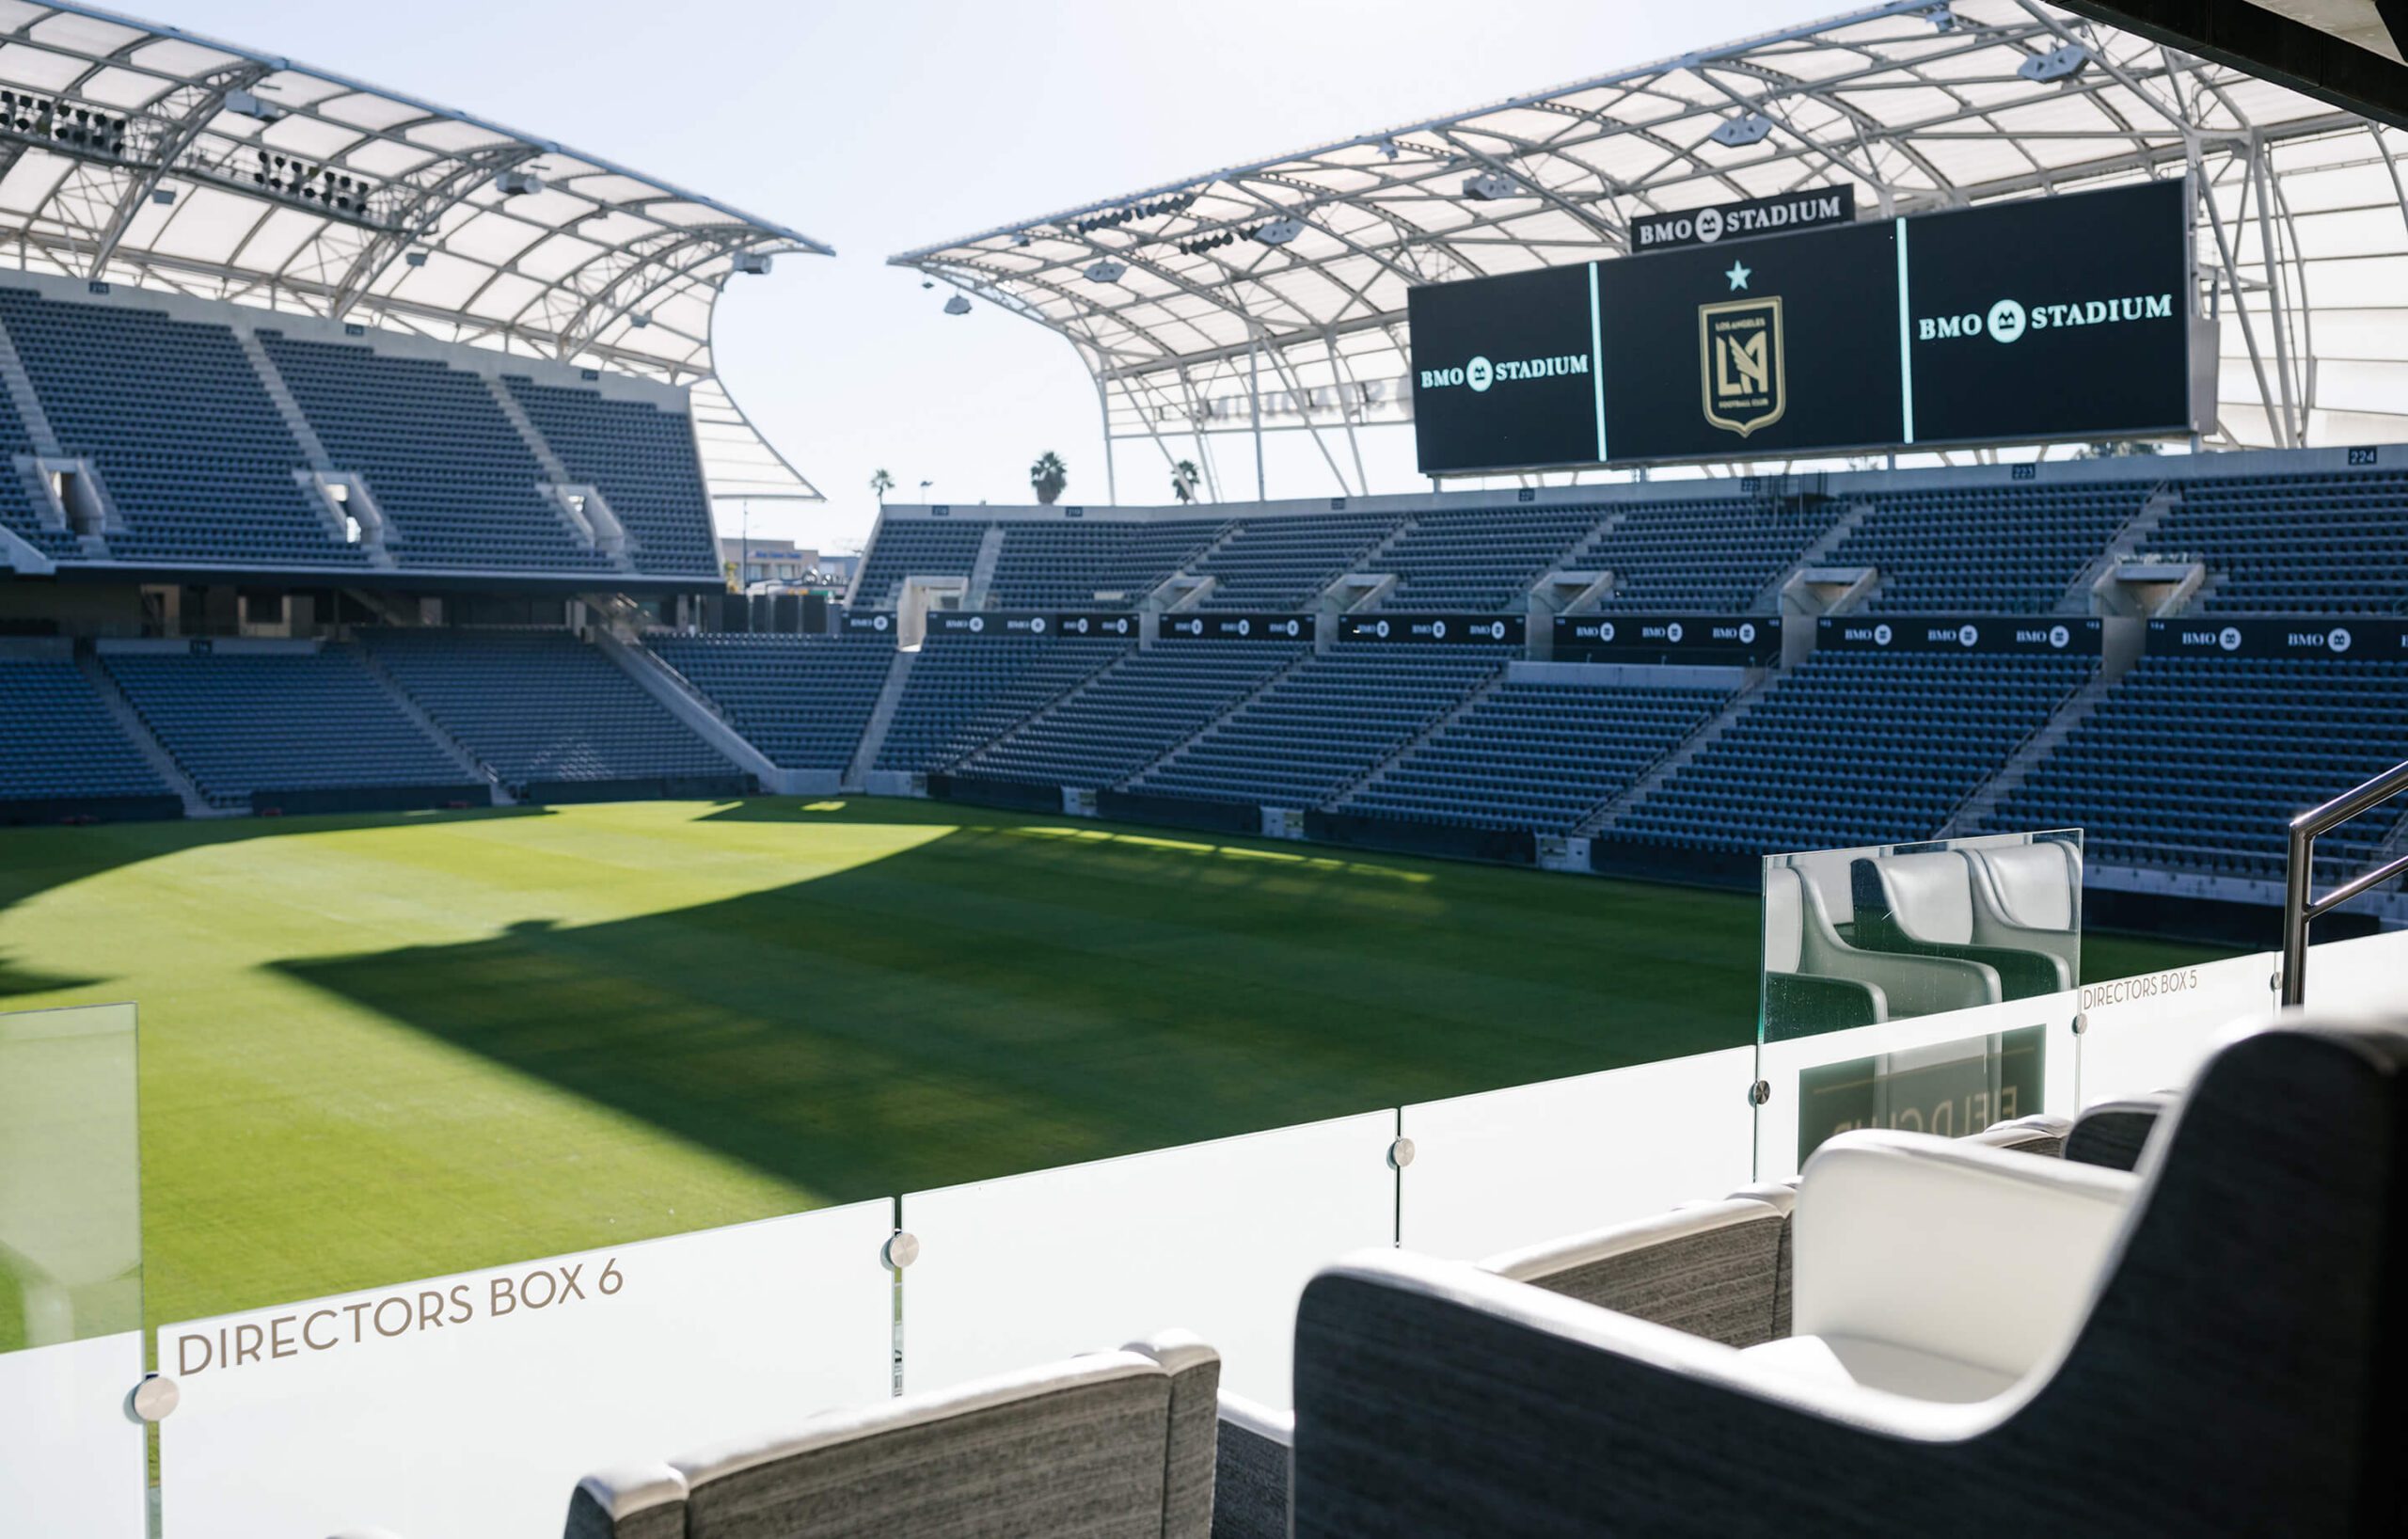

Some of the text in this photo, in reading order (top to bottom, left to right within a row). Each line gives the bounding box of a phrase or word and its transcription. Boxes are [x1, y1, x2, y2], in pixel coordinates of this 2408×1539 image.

[1640, 196, 1841, 245] BMO STADIUM
[1919, 294, 2172, 341] BMO STADIUM
[1420, 354, 1589, 389] BMO STADIUM
[2351, 450, 2374, 462] 224
[1576, 627, 1596, 637] BMO
[1642, 627, 1666, 638] BMO
[1713, 627, 1738, 639] BMO
[1844, 628, 1871, 641] BMO
[1927, 629, 1957, 642] BMO
[2016, 630, 2047, 643] BMO
[2181, 632, 2216, 645] BMO
[2288, 633, 2324, 647] BMO
[2083, 969, 2197, 1010] DIRECTORS BOX 5
[178, 1258, 624, 1377] DIRECTORS BOX 6
